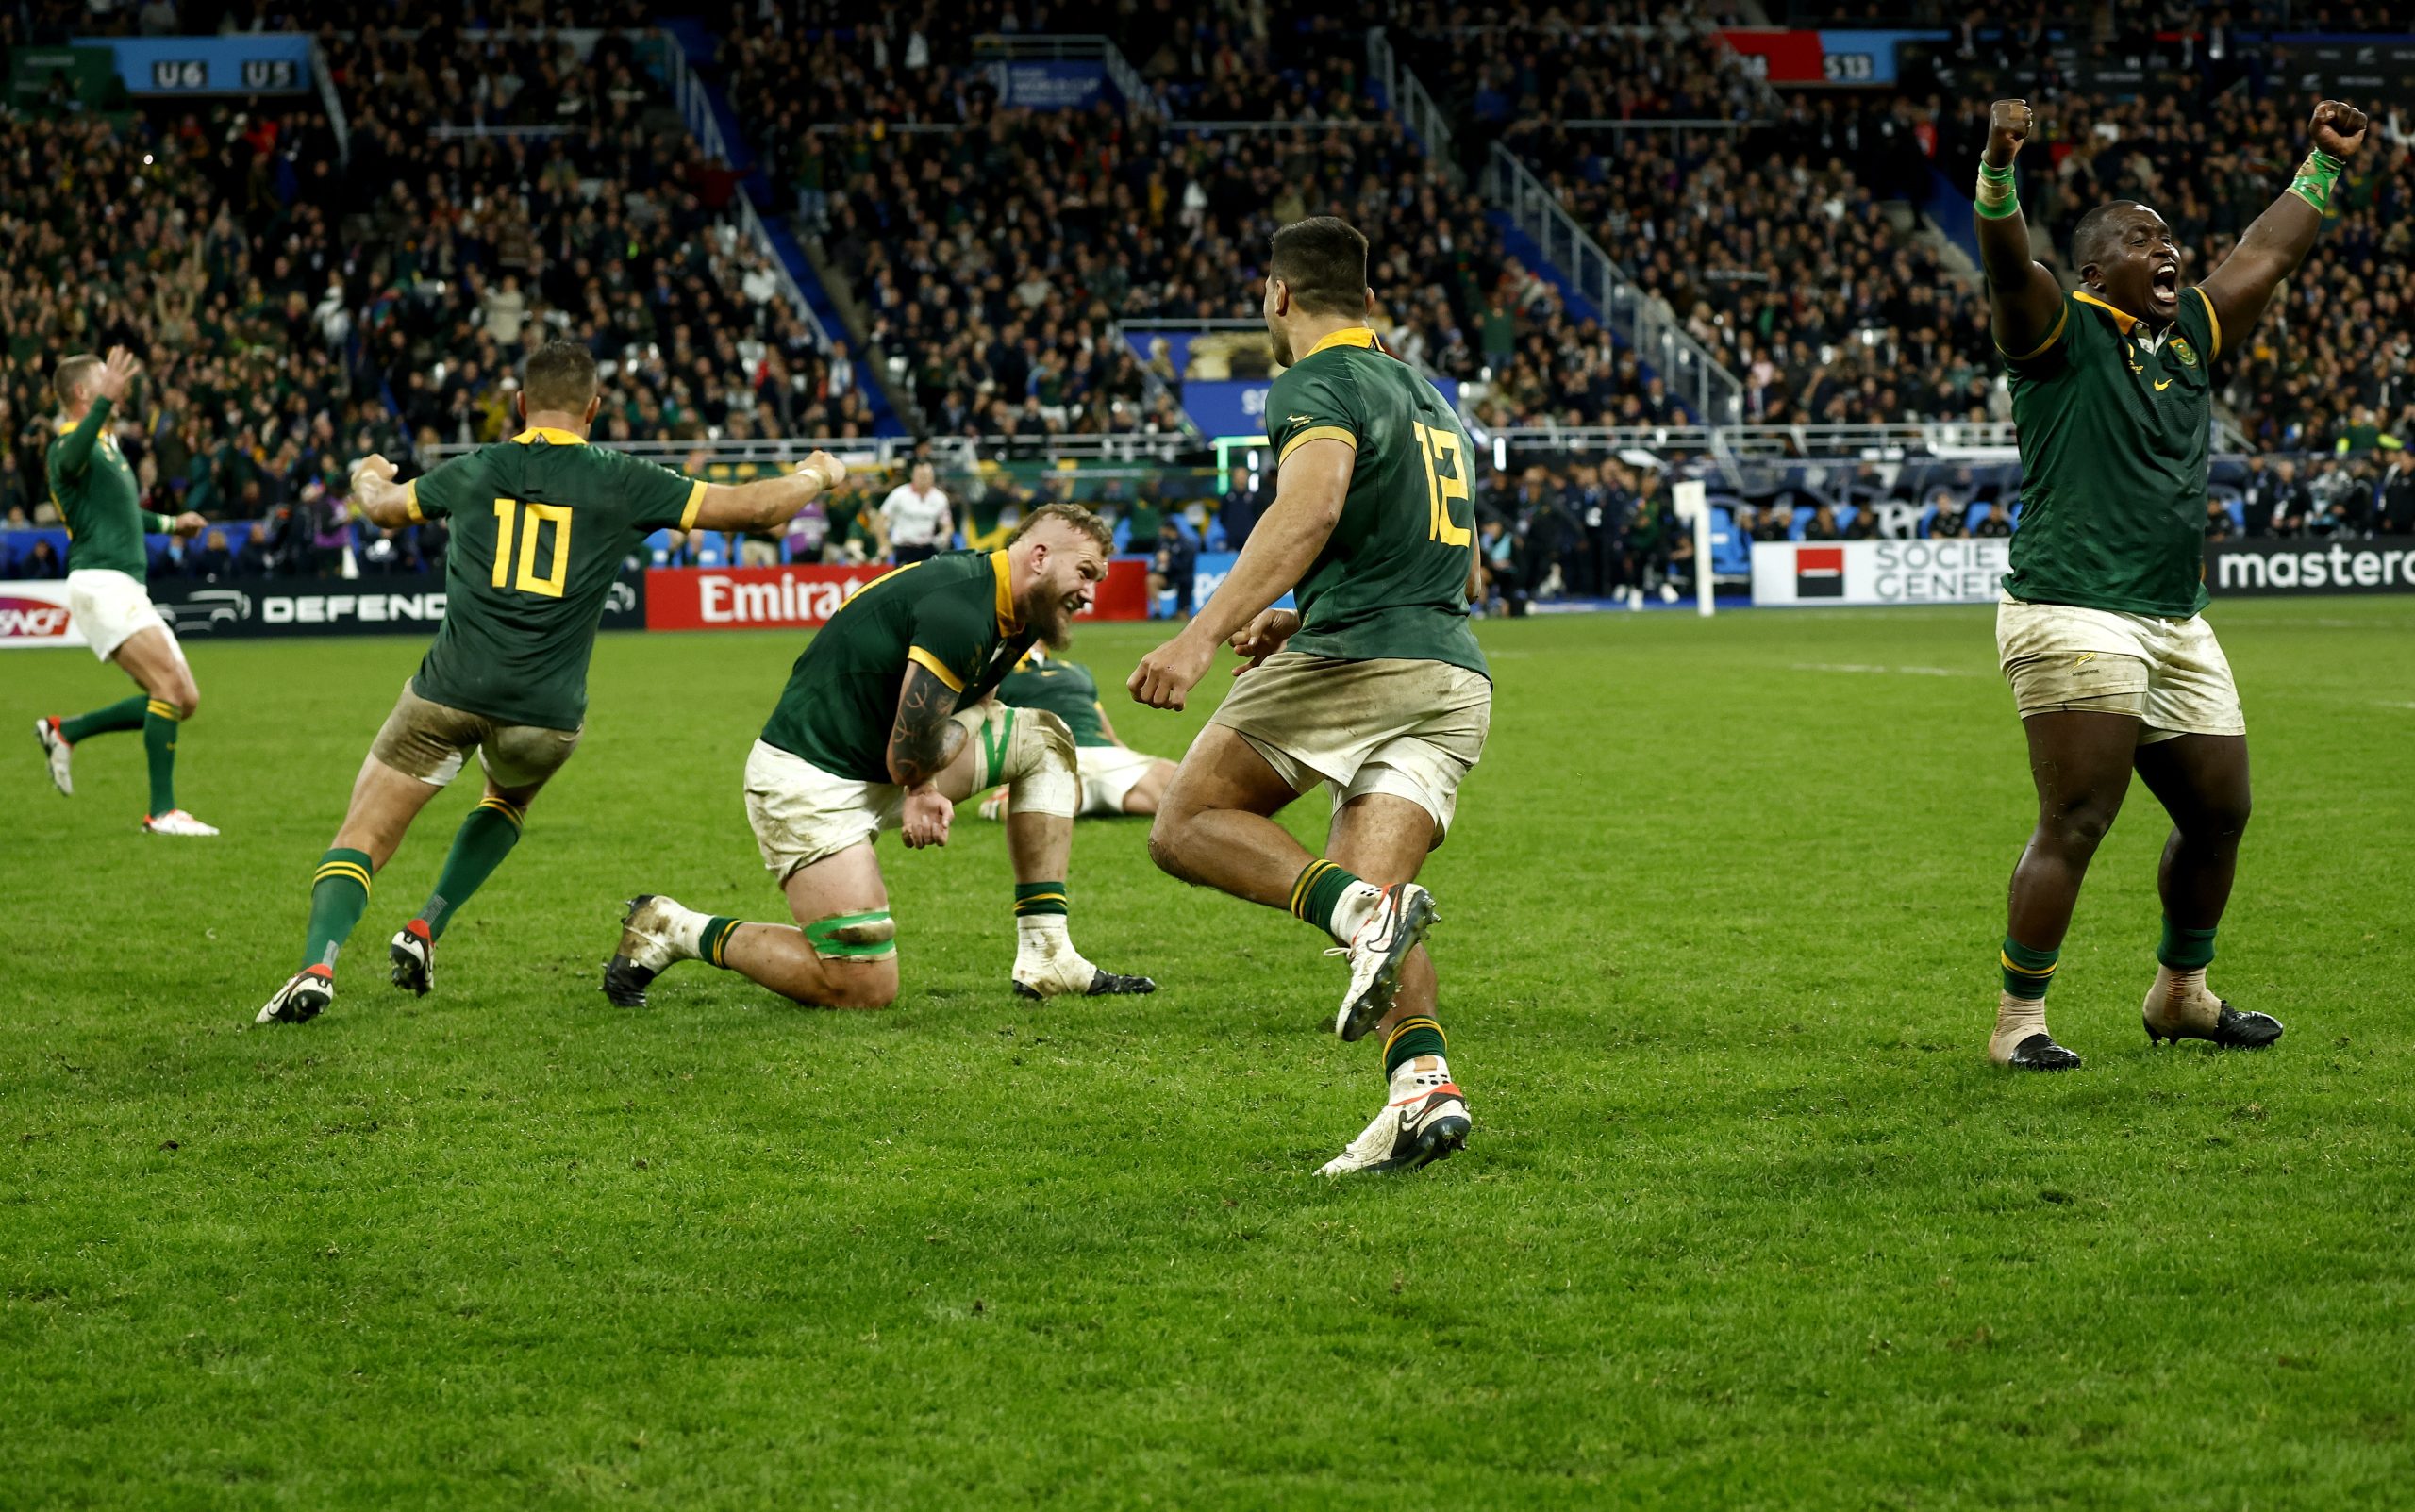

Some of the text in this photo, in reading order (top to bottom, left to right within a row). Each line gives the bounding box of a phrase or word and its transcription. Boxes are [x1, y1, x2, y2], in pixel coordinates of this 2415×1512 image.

[157, 60, 204, 89] U6
[1412, 420, 1472, 549] 12
[491, 497, 574, 598] 10
[262, 593, 448, 623] DEFEND
